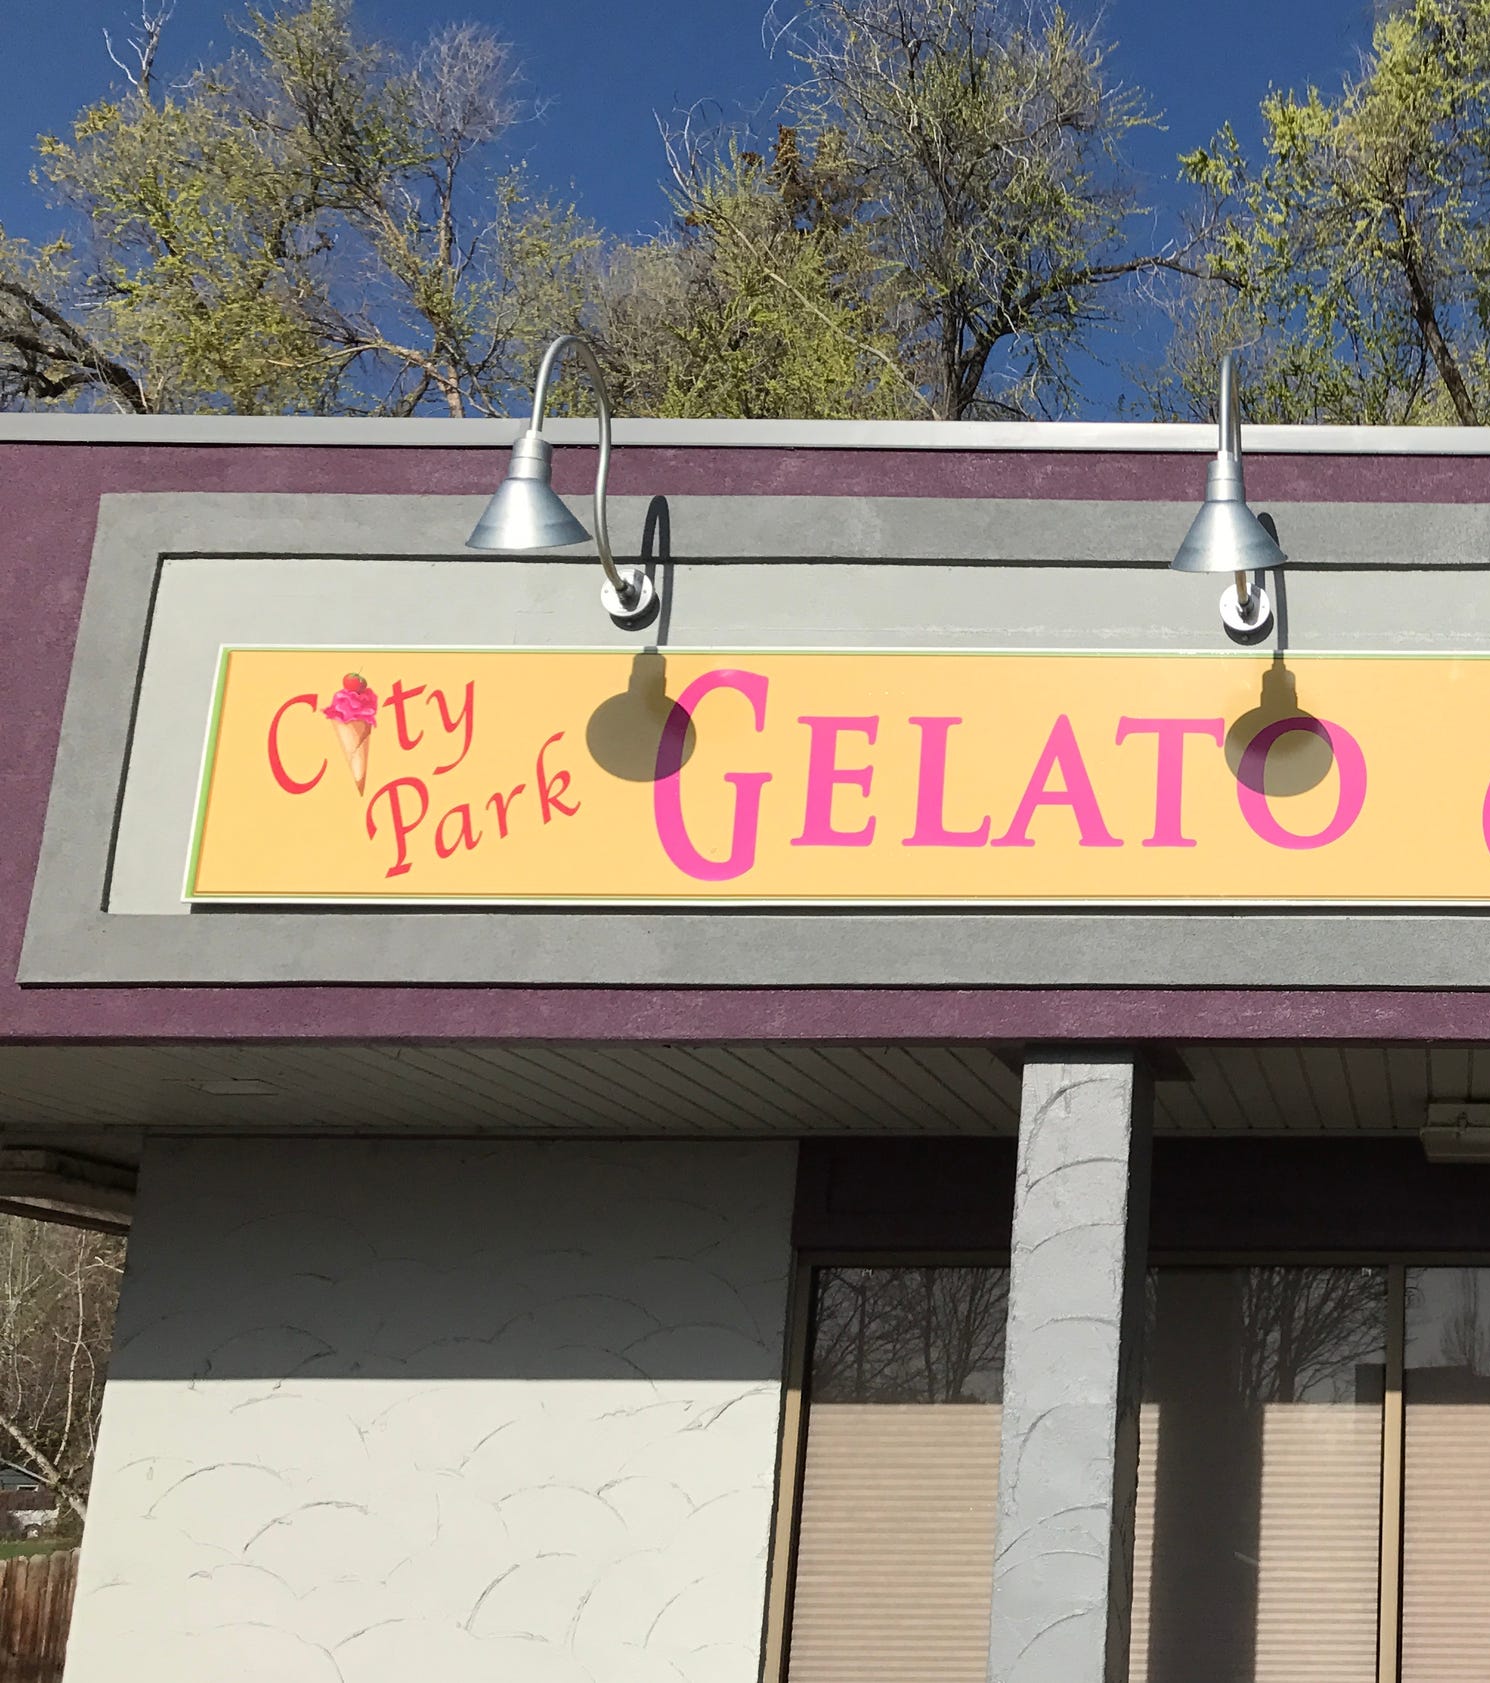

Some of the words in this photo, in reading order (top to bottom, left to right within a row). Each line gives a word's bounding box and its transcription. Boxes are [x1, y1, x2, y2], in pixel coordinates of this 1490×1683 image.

[268, 674, 475, 796] Cty
[366, 730, 582, 878] Park
[653, 669, 1367, 882] GELATO
